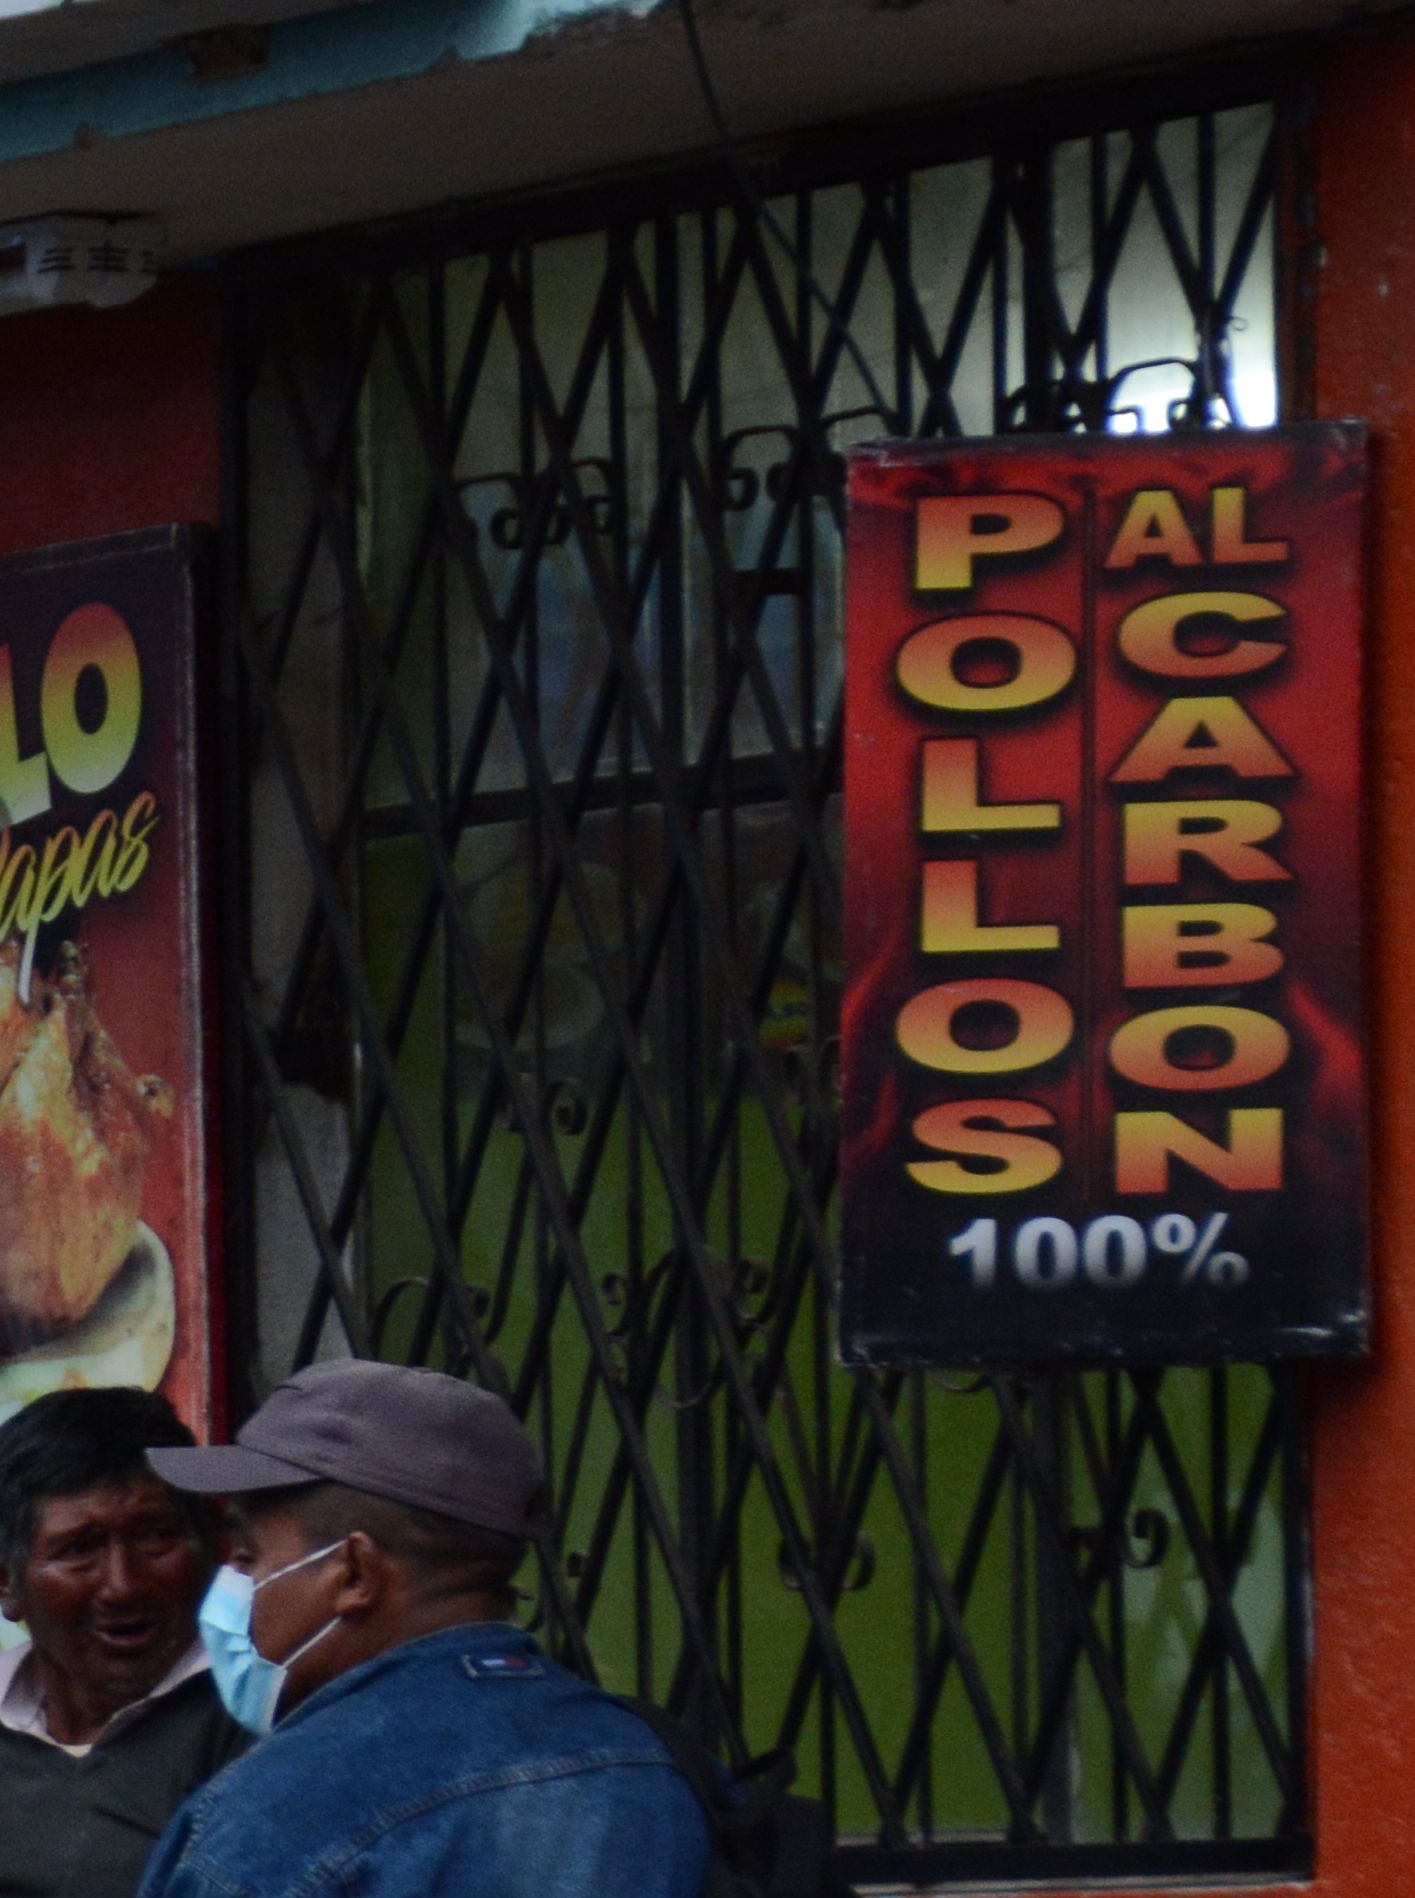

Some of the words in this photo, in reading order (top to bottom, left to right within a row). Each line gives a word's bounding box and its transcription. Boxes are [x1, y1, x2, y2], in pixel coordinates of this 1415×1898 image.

[1105, 487, 1290, 568] AL
[896, 493, 1076, 1195] POLLOS
[1108, 592, 1298, 1194] CARBON
[948, 1212, 1250, 1290] 100%
